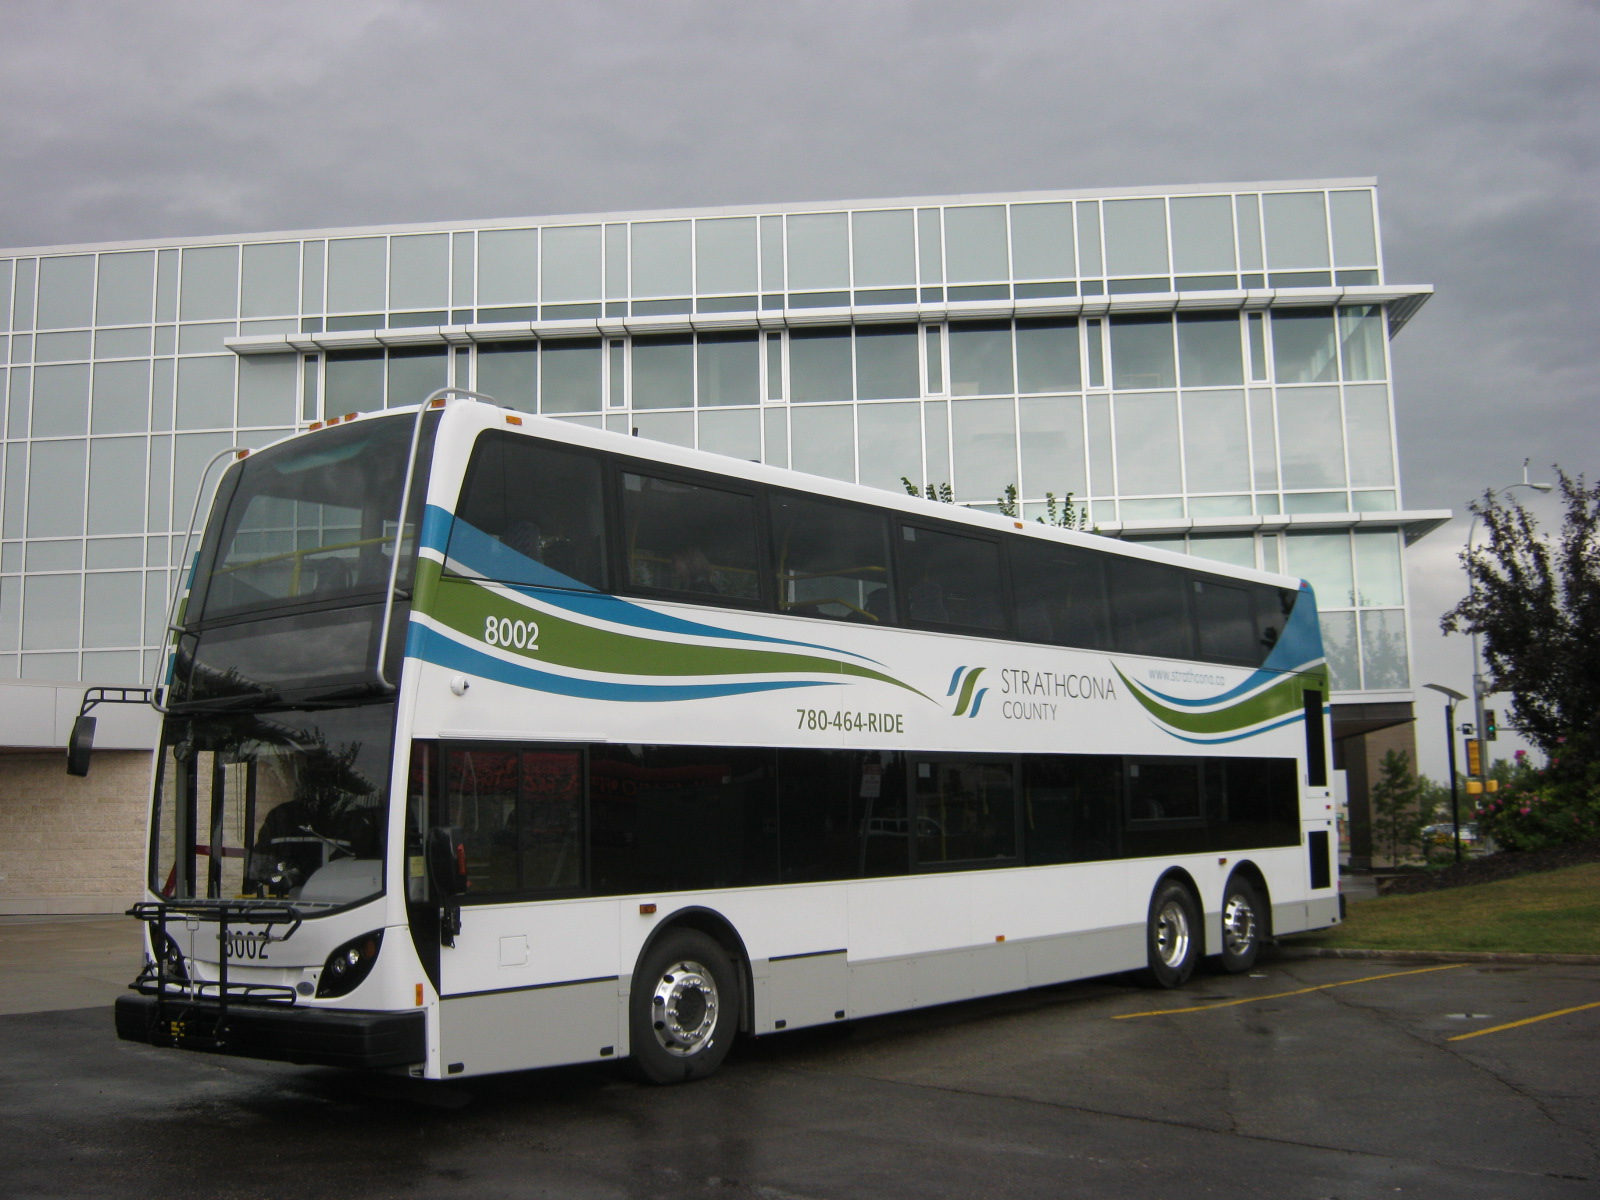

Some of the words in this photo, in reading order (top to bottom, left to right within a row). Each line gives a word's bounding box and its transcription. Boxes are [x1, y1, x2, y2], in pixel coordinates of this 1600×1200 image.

[485, 615, 539, 651] 8002
[1001, 668, 1117, 700] STRATHCONA
[796, 708, 904, 734] 780-464-RIDE
[1002, 700, 1057, 720] COUNTY
